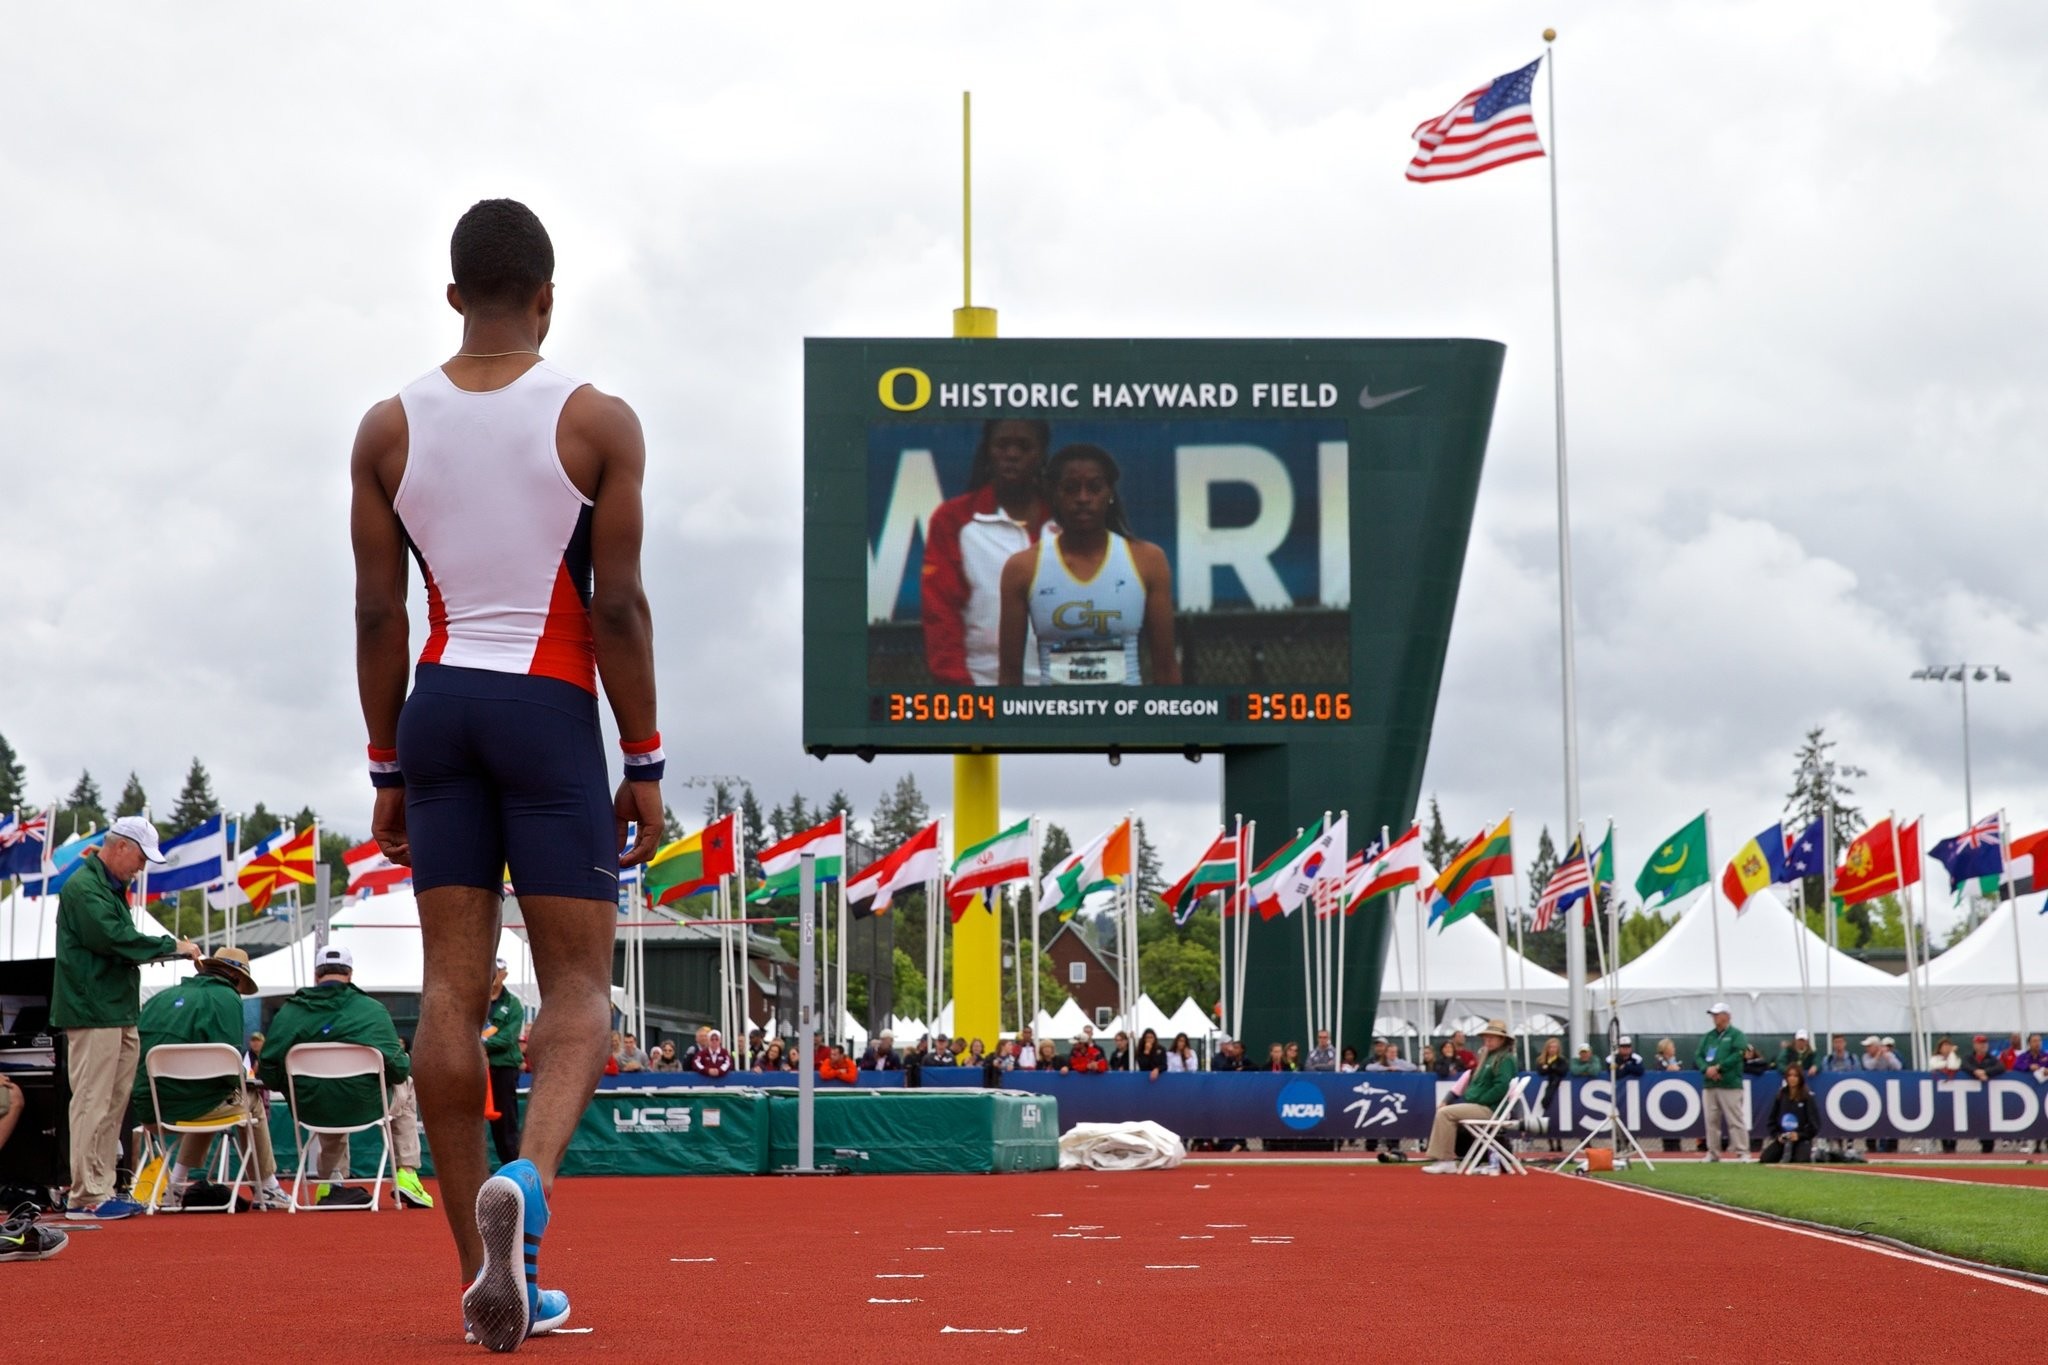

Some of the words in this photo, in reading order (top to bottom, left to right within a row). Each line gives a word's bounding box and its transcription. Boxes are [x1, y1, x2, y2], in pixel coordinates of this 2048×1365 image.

[940, 383, 1079, 407] HISTORIC
[1092, 383, 1239, 408] HAYWARD
[1252, 383, 1338, 408] FIELD
[890, 693, 995, 721] 3:50.04
[1002, 700, 1108, 716] UNIVERSITY
[1114, 700, 1138, 716] OF
[1144, 700, 1219, 716] OREGON
[1248, 693, 1351, 721] 3:50.06
[613, 1107, 692, 1126] UCS
[1281, 1104, 1325, 1118] NCAA
[1825, 1078, 2048, 1133] OUTD
